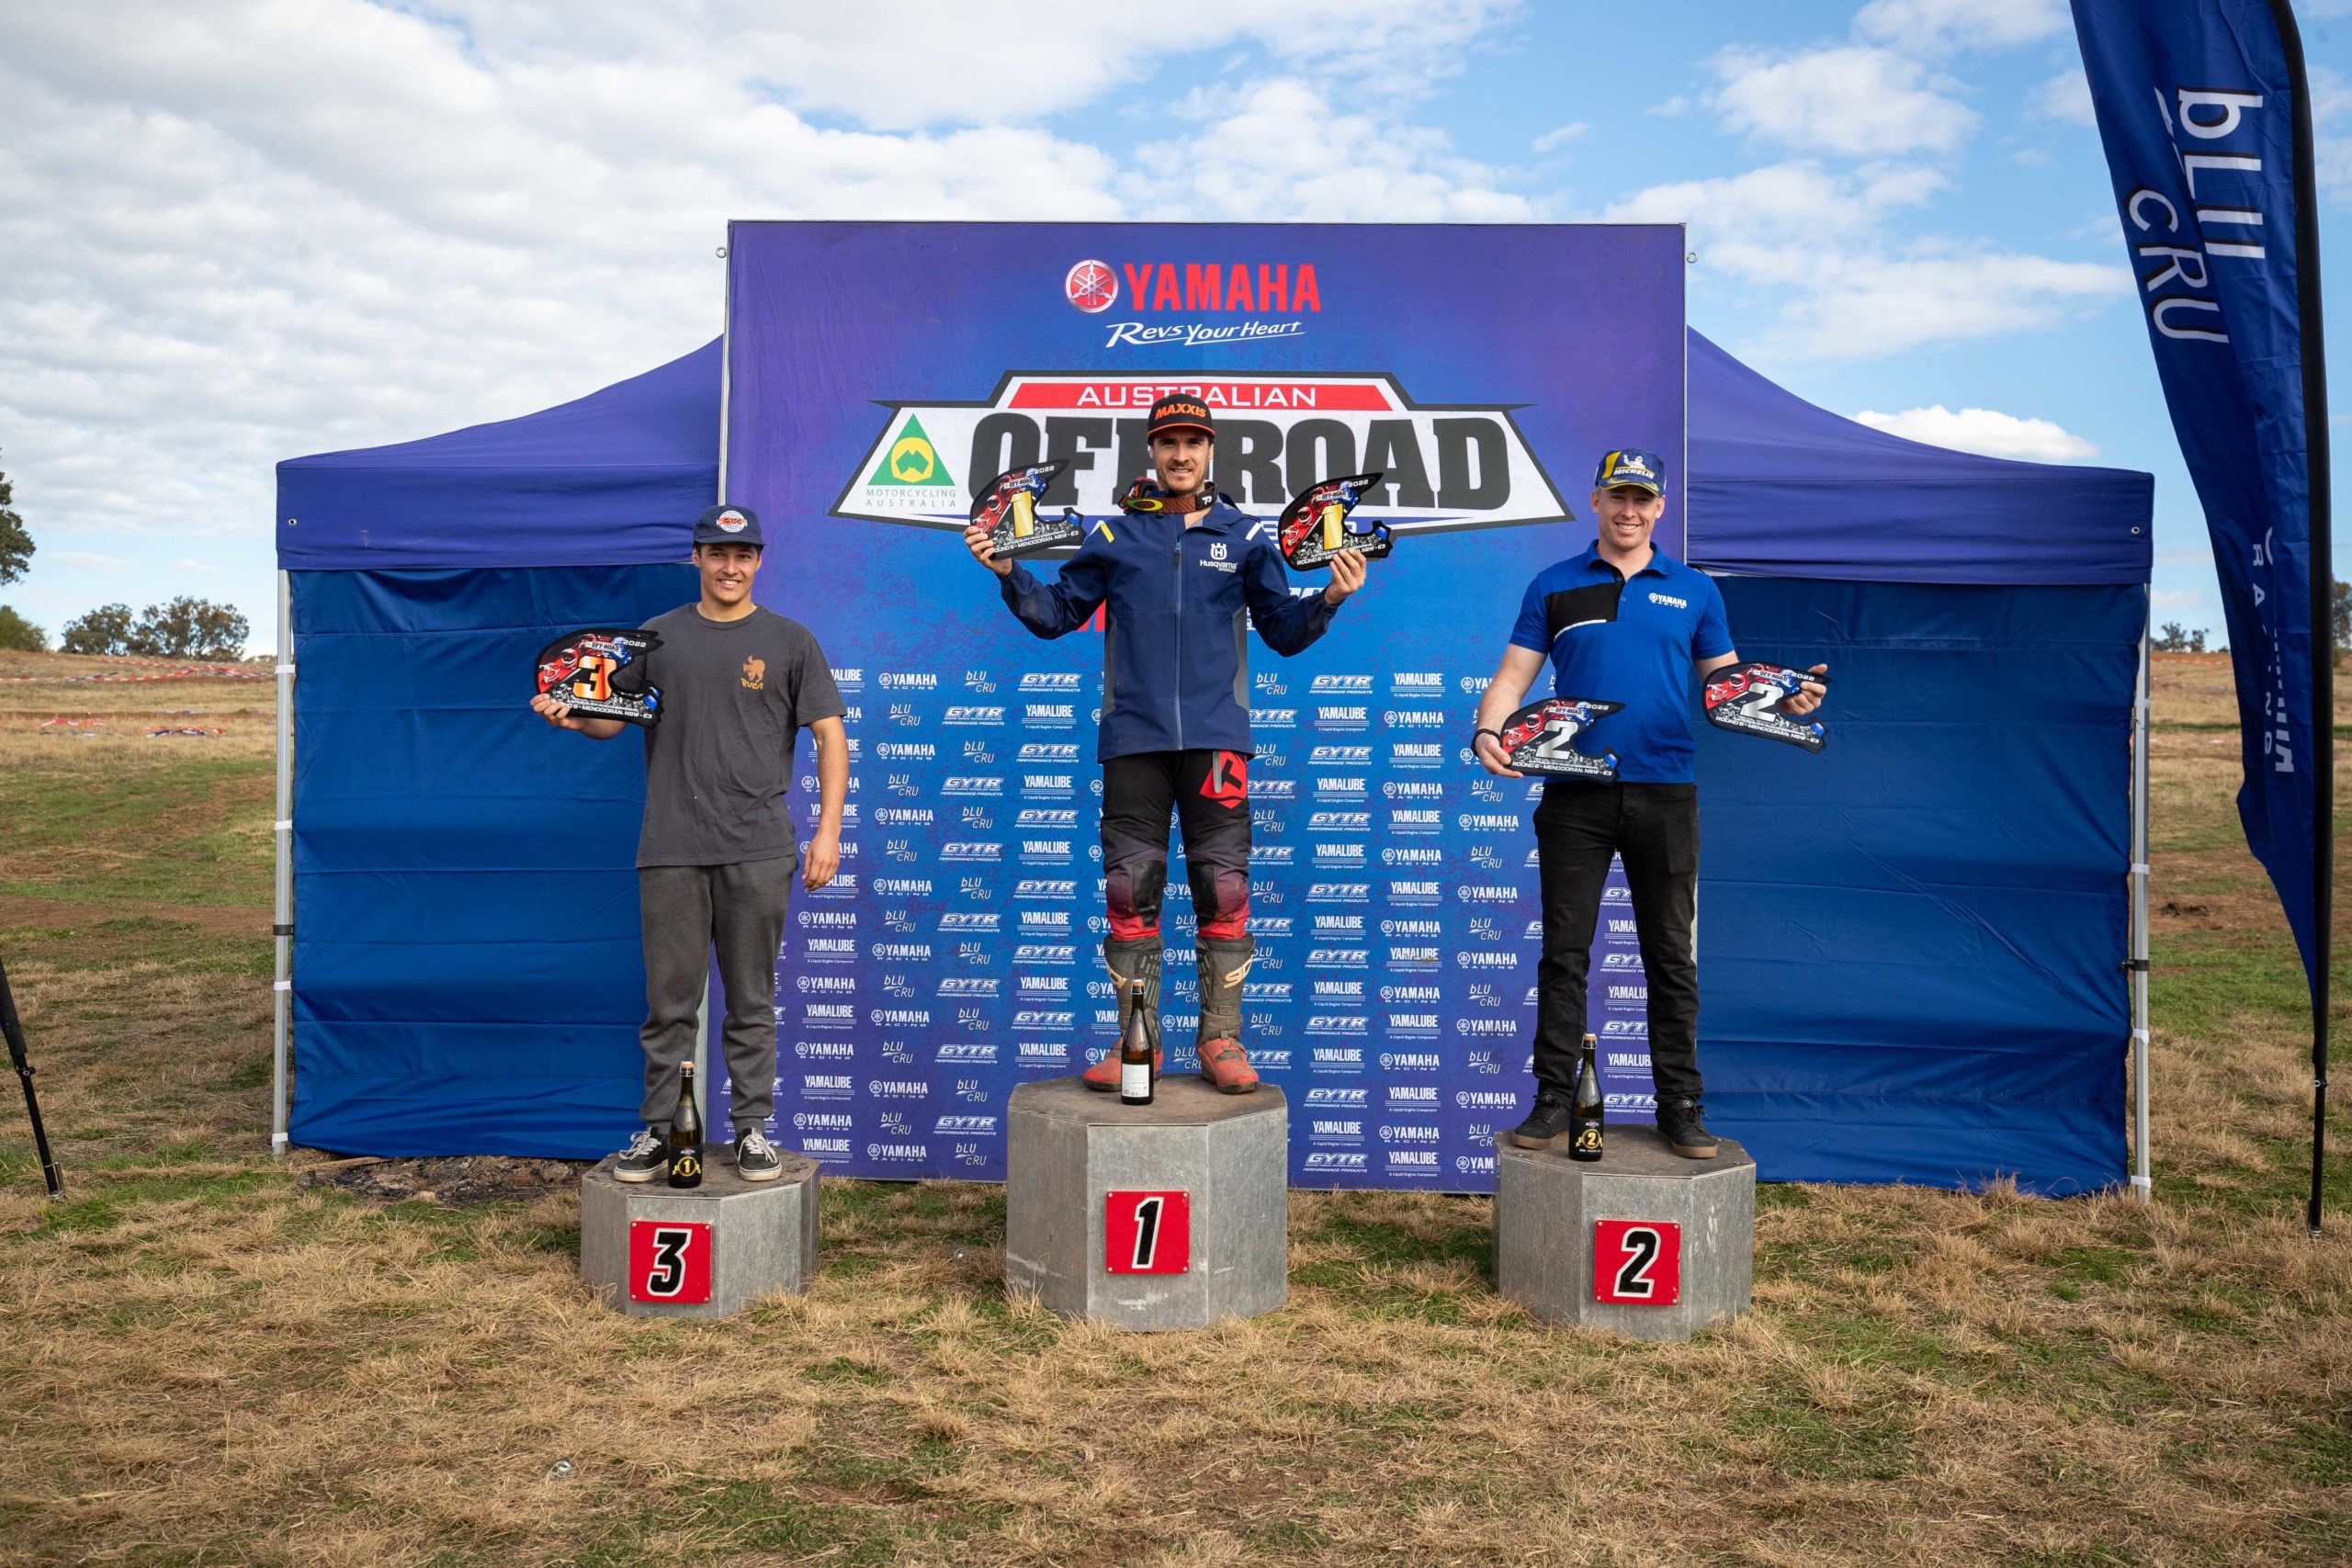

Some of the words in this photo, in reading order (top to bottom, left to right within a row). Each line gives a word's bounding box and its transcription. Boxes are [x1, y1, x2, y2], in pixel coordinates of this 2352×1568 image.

[1123, 263, 1322, 312] YAMAHA
[1105, 321, 1185, 348] Revs
[1183, 322, 1240, 346] Your
[1239, 321, 1303, 337] Heart
[1155, 403, 1206, 420] MAXXIS
[1613, 468, 1654, 479] MICHELIN
[865, 489, 956, 497] MOTORCYCLING
[865, 499, 956, 507] AUSTRALIA
[1010, 490, 1035, 538] 1
[1321, 503, 1343, 550] 1
[1199, 558, 1238, 570] Husqvarna
[1658, 593, 1687, 607] YAMAHA
[572, 655, 617, 701] 3
[893, 674, 937, 685] YAMAHA
[1021, 673, 1081, 685] GYTR
[1311, 675, 1374, 687] GYTR
[1395, 673, 1442, 685] YAMALUBE
[1739, 682, 1784, 723] 2
[944, 706, 1005, 717] GYTR
[1025, 705, 1073, 716] YAMALUBE
[1318, 706, 1366, 719] YAMALUBE
[1398, 712, 1444, 724] YAMAHA
[1715, 716, 1739, 726] ROUND
[1535, 719, 1579, 761] 2
[891, 744, 935, 755] YAMAHA
[1019, 744, 1080, 755] GYTR
[1310, 746, 1373, 758] GYTR
[1393, 744, 1442, 757] YAMALUBE
[943, 777, 1003, 788] GYTR
[1023, 775, 1071, 788] YAMALUBE
[1317, 778, 1365, 790] YAMALUBE
[1396, 783, 1442, 795] YAMAHA
[889, 808, 933, 821] YAMAHA
[1016, 809, 1079, 821] GYTR
[1310, 812, 1372, 824] GYTR
[1393, 810, 1439, 823] YAMALUBE
[1474, 815, 1519, 827] YAMAHA
[941, 842, 1003, 854] GYTR
[1023, 840, 1070, 853] YAMALUBE
[1316, 844, 1363, 856] YAMALUBE
[1396, 849, 1442, 861] YAMAHA
[888, 880, 932, 891] YAMAHA
[1016, 880, 1078, 892] GYTR
[1307, 884, 1370, 896] GYTR
[1391, 882, 1439, 895] YAMALUBE
[1472, 886, 1518, 898] YAMAHA
[812, 913, 856, 924] YAMAHA
[939, 913, 1001, 925] GYTR
[1022, 912, 1069, 924] YAMALUBE
[1316, 916, 1362, 928] YAMALUBE
[1395, 920, 1441, 932] YAMAHA
[808, 939, 854, 952] YAMALUBE
[886, 944, 931, 957] YAMAHA
[1014, 945, 1077, 957] GYTR
[1308, 950, 1369, 961] GYTR
[1472, 953, 1517, 964] YAMAHA
[810, 977, 855, 988] YAMAHA
[939, 978, 1000, 990] GYTR
[1020, 977, 1069, 990] YAMALUBE
[1314, 982, 1363, 994] YAMALUBE
[1395, 987, 1440, 998] YAMAHA
[807, 1005, 853, 1018] YAMALUBE
[1012, 1011, 1075, 1023] GYTR
[1306, 1016, 1369, 1028] GYTR
[1389, 1015, 1438, 1027] YAMALUBE
[1470, 1020, 1516, 1032] YAMAHA
[808, 1043, 854, 1055] YAMAHA
[937, 1044, 999, 1056] GYTR
[1020, 1043, 1066, 1056] YAMALUBE
[1314, 1049, 1362, 1062] YAMALUBE
[1394, 1055, 1440, 1066] YAMAHA
[805, 1076, 851, 1088] YAMALUBE
[884, 1082, 928, 1093] YAMAHA
[1306, 1089, 1368, 1100] GYTR
[1389, 1087, 1437, 1100] YAMALUBE
[1470, 1092, 1516, 1104] YAMAHA
[807, 1113, 852, 1126] YAMAHA
[936, 1116, 997, 1128] GYTR
[1314, 1122, 1362, 1134] YAMALUBE
[1394, 1127, 1440, 1139] YAMAHA
[1588, 1132, 1596, 1145] 2
[803, 1139, 851, 1152] YAMALUBE
[882, 1145, 926, 1157] YAMAHA
[1306, 1153, 1368, 1165] GYTR
[1389, 1152, 1437, 1165] YAMALUBE
[1131, 1196, 1164, 1269] 1
[647, 1227, 692, 1296] 3
[1612, 1226, 1661, 1298] 2
